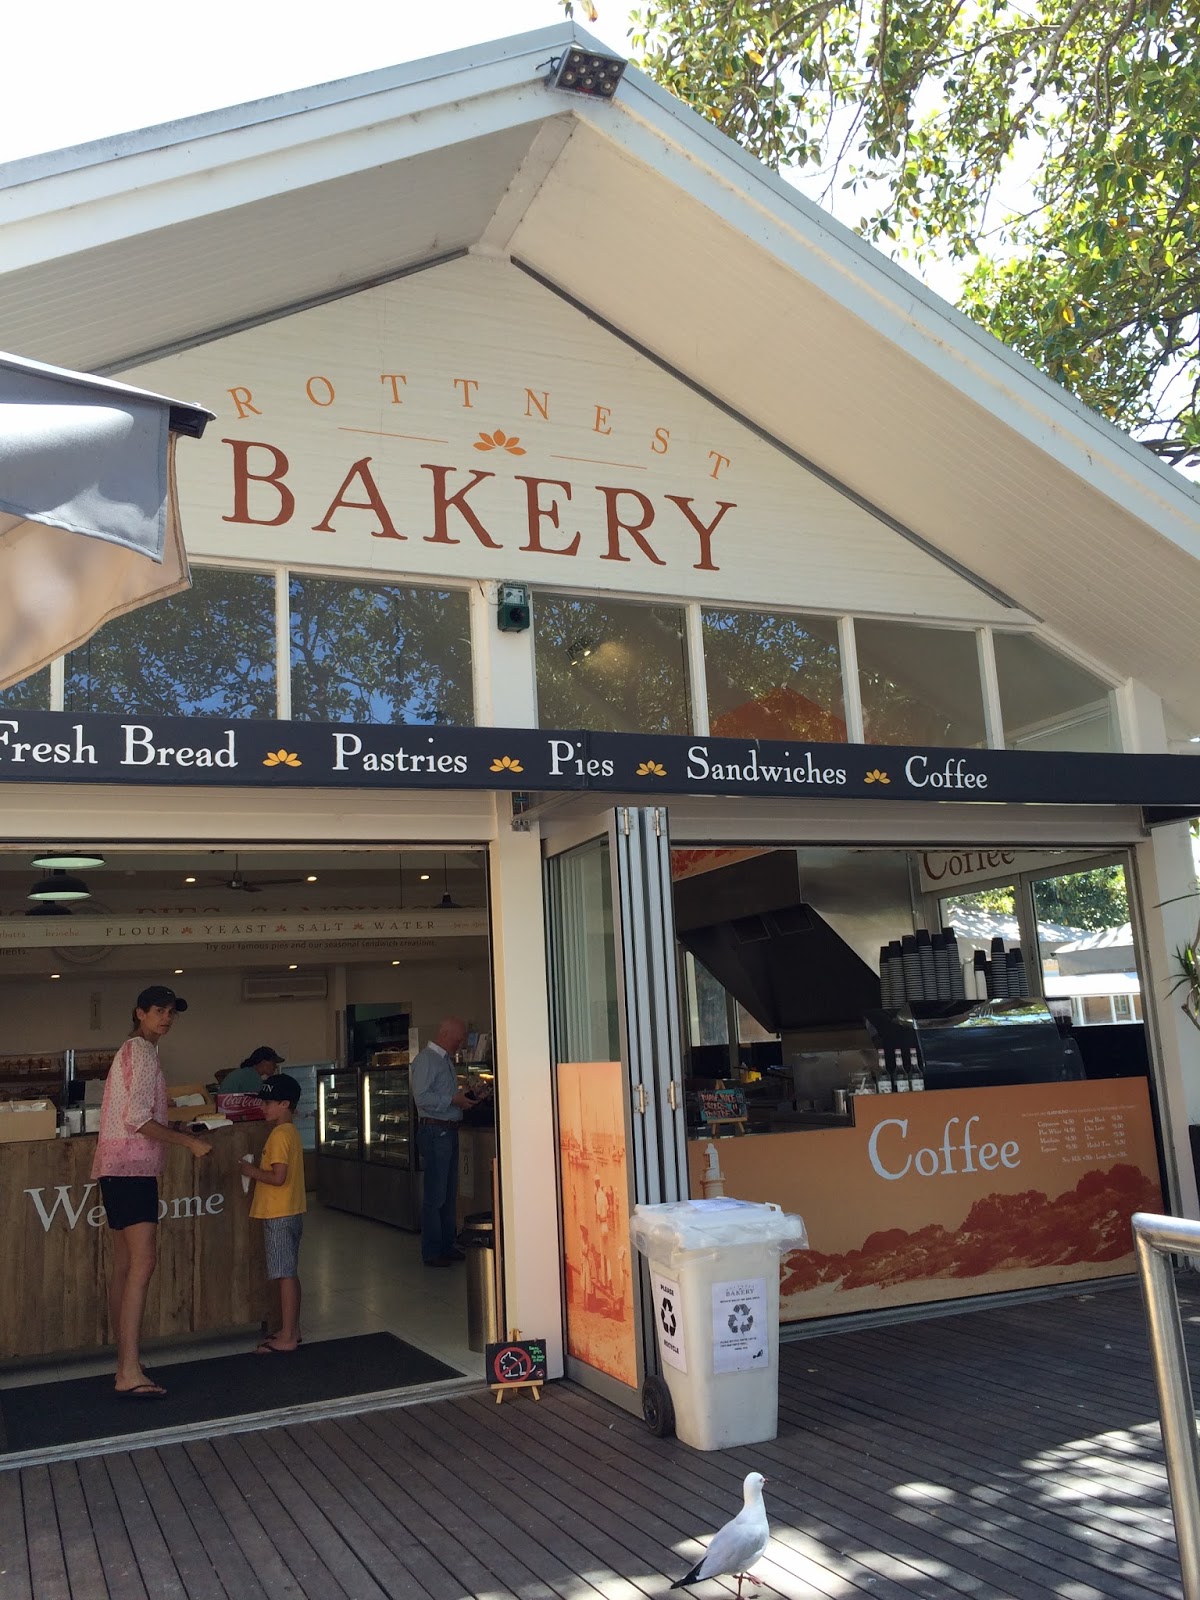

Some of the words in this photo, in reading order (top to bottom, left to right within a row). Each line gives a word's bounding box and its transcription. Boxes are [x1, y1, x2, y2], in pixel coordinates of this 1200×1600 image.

[227, 375, 730, 480] ROTTNEST
[222, 438, 737, 571] BAKERY
[120, 724, 238, 768] Bread
[332, 733, 468, 773] Pastries
[548, 740, 614, 777] Pies
[686, 746, 847, 785] Sandwiches
[904, 755, 988, 790] Coffee
[106, 927, 169, 936] FLOUR
[203, 924, 267, 935] YEAST
[298, 922, 344, 931] SALT
[374, 921, 435, 930] WATER
[205, 943, 219, 952] Try
[237, 942, 269, 950] famous
[271, 942, 288, 951] pies
[290, 941, 306, 949] and
[324, 940, 359, 948] seasonal
[361, 939, 398, 948] sandwich
[868, 1116, 1021, 1180] Coffee
[23, 1183, 225, 1232] Weome
[660, 1284, 674, 1297] PLEASE
[726, 1288, 755, 1297] BAKERY
